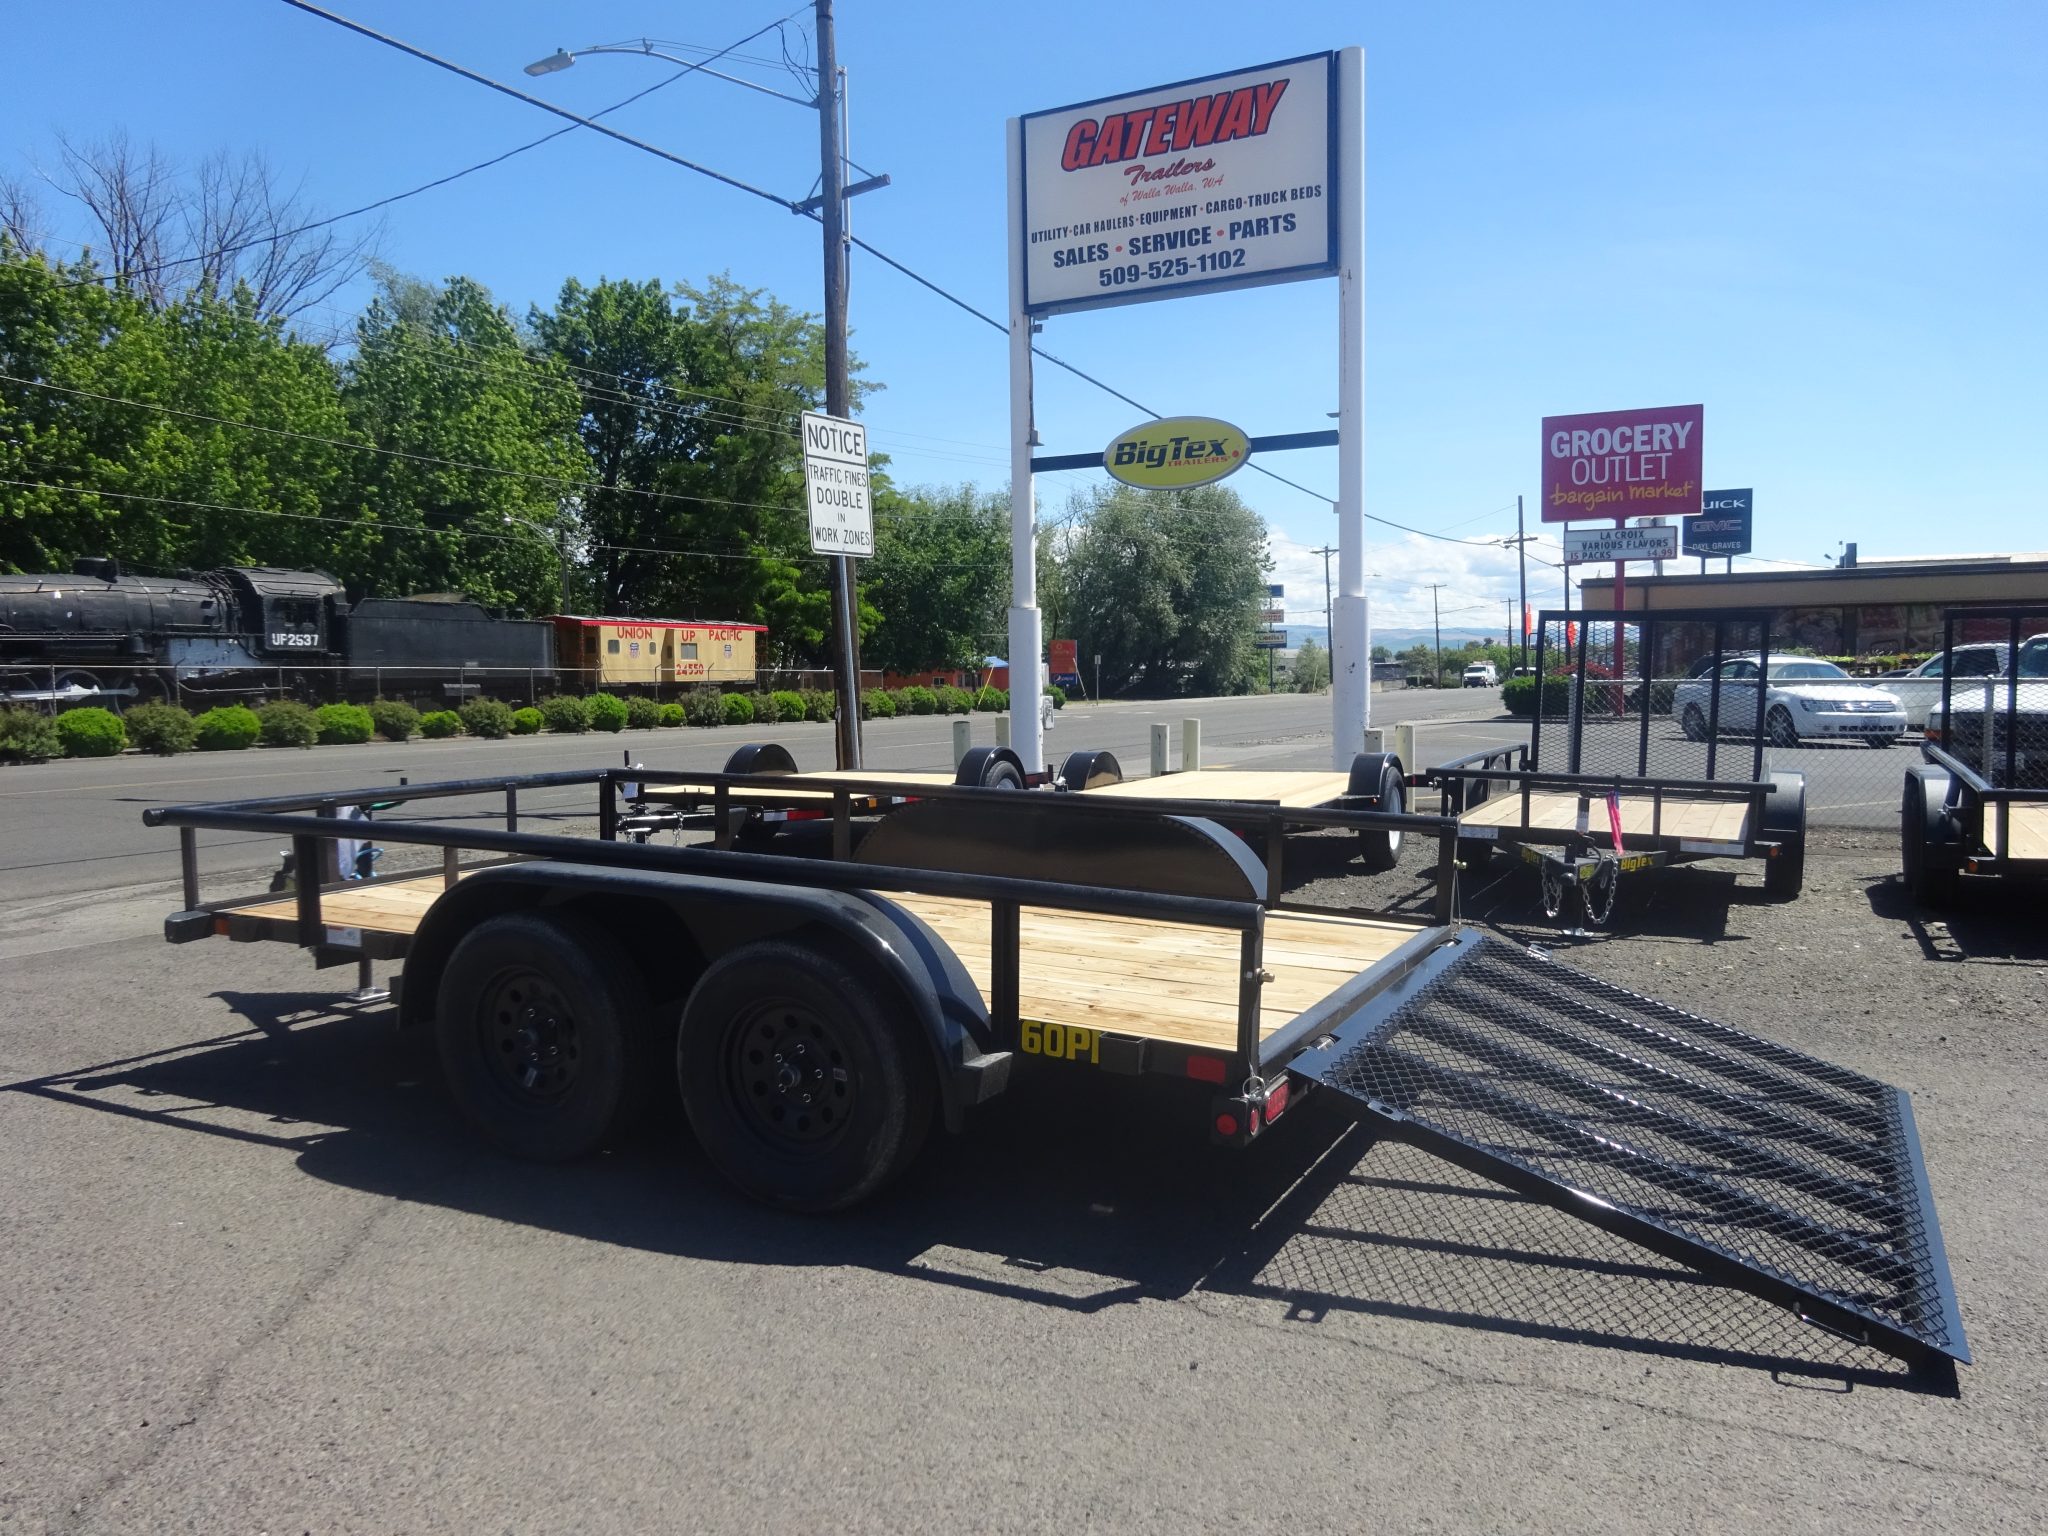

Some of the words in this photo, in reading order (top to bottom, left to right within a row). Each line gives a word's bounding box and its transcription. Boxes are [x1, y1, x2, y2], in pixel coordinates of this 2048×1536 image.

[1061, 79, 1290, 172] GATEWAY
[1124, 157, 1216, 186] Trailers
[1120, 194, 1128, 206] of
[1132, 187, 1161, 201] Walla
[1164, 182, 1197, 198] Walla,
[1202, 174, 1224, 189] WA
[1031, 226, 1069, 244] UTILITY
[1073, 222, 1091, 236] CAR
[1094, 215, 1134, 233] HAULERS
[1140, 205, 1198, 226] EQUIPMENT
[1206, 197, 1243, 214] CARGO
[1248, 191, 1288, 208] TRUCK
[1290, 185, 1322, 201] BEDS
[1053, 242, 1109, 268] SALES
[1129, 226, 1212, 256] SERVICE
[1229, 213, 1297, 241] PARTS
[1099, 248, 1246, 287] 509-525-1102
[808, 423, 863, 457] NOTICE
[1551, 421, 1693, 458] GROCERY
[1168, 455, 1229, 467] TRAILERS
[1571, 452, 1673, 485] OUTLET
[809, 464, 842, 484] TRAFFIC
[845, 471, 867, 488] FINES
[817, 487, 863, 509] DOUBLE
[1550, 483, 1623, 511] bargain
[1629, 480, 1693, 499] market
[1703, 499, 1746, 509] UICK
[838, 513, 846, 523] IN
[1692, 520, 1742, 532] GMC
[815, 526, 839, 543] WORK
[844, 530, 871, 546] ZONES
[1582, 541, 1623, 550] VARIOUS
[1626, 538, 1669, 548] FLAVORS
[1600, 531, 1611, 540] LA
[1615, 530, 1645, 539] CROIX
[1712, 541, 1741, 550] GRAVES
[1570, 552, 1579, 561] 15
[1583, 551, 1611, 560] PACKS
[271, 633, 319, 646] UP2537
[616, 627, 653, 640] UNION
[681, 630, 696, 642] UP
[709, 630, 743, 641] PACIFIC
